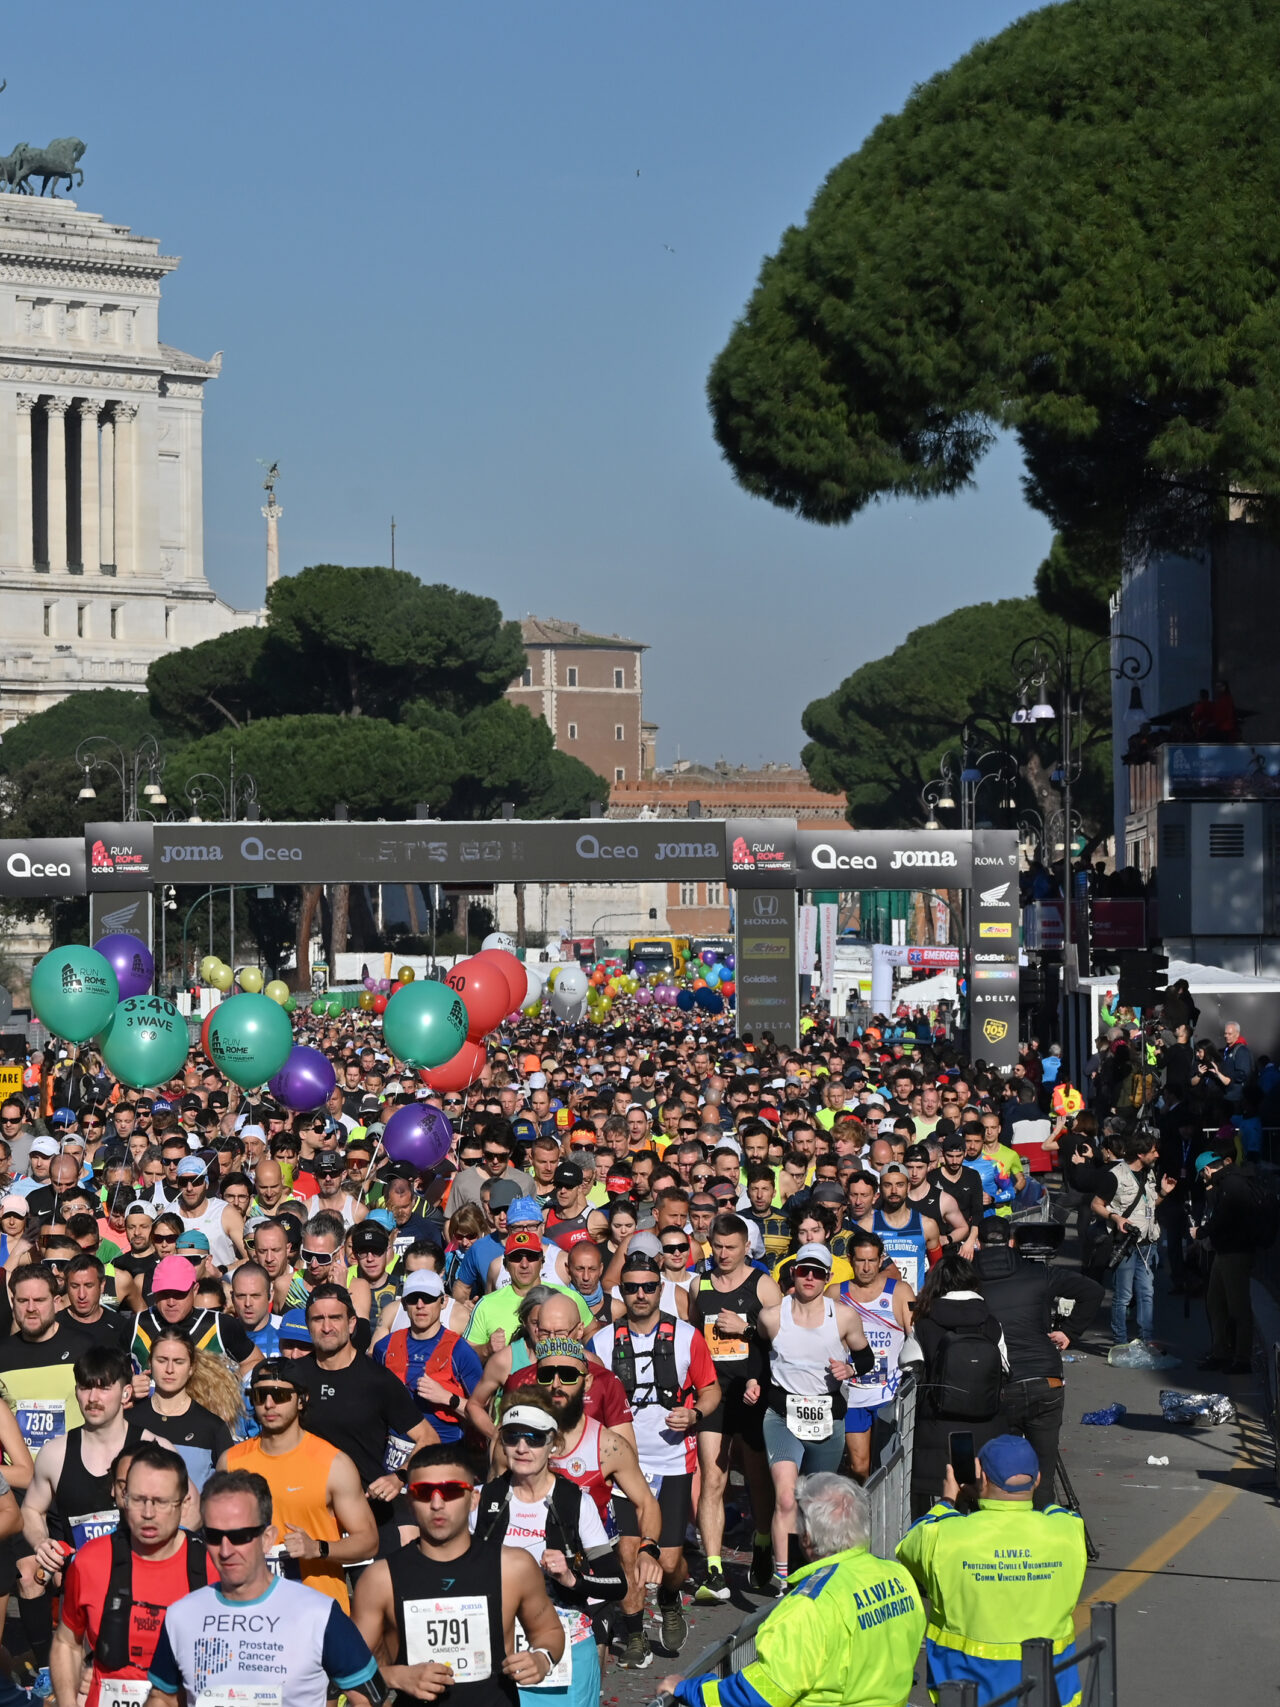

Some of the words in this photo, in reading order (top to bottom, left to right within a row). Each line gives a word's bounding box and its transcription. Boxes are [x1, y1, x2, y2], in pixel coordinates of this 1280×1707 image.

[110, 846, 133, 855] RUN
[655, 842, 719, 860] joma
[752, 843, 775, 852] RUN
[115, 855, 143, 863] ROME
[160, 845, 224, 863] joma
[756, 852, 784, 860] ROME
[890, 850, 957, 869] joma
[974, 857, 1004, 865] ROMA
[923, 950, 960, 960] EMERGEN
[80, 967, 99, 976] RUN
[85, 976, 106, 986] ROME
[124, 997, 176, 1017] 3:40
[126, 1017, 133, 1027] 3
[137, 1016, 173, 1032] WAVE
[986, 1025, 1004, 1036] 105
[225, 1045, 248, 1054] ROME
[862, 1331, 892, 1339] ETICA
[729, 1346, 736, 1354] A
[320, 1385, 336, 1397] Fe
[796, 1406, 824, 1421] 5666
[26, 1412, 54, 1431] 7378
[386, 1448, 407, 1469] 3921
[504, 1529, 546, 1538] UNGAR
[202, 1614, 281, 1633] PERCY
[426, 1618, 470, 1647] 5791
[239, 1640, 284, 1652] Prostate
[238, 1651, 276, 1662] Cancer
[238, 1662, 287, 1674] Research
[457, 1658, 468, 1669] D
